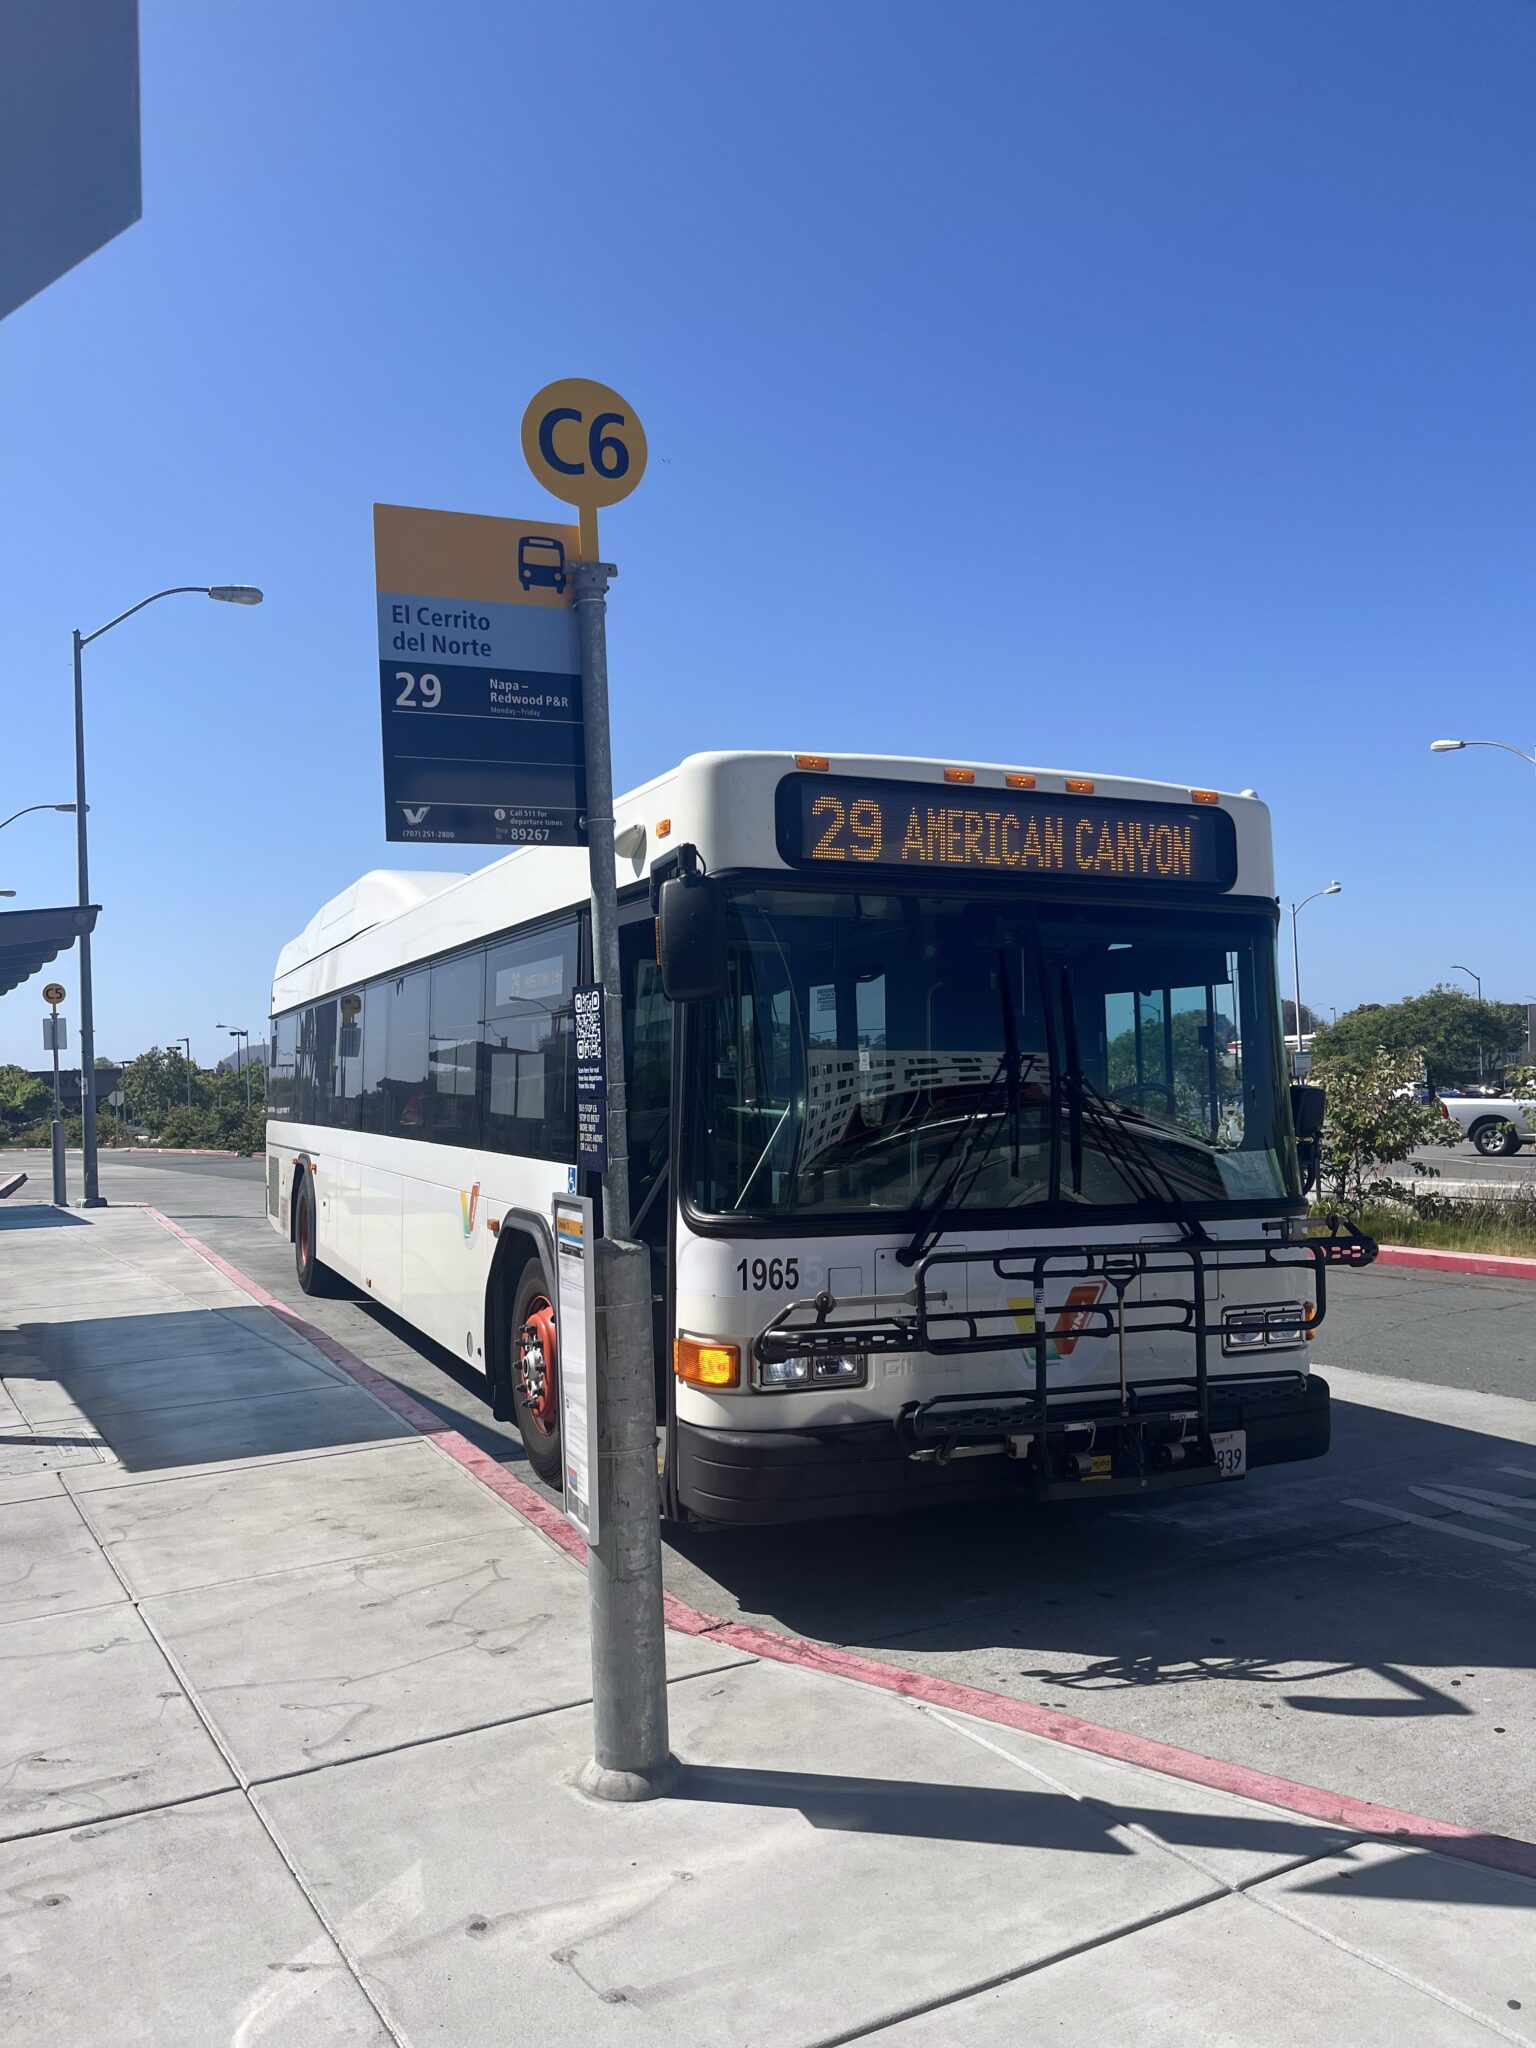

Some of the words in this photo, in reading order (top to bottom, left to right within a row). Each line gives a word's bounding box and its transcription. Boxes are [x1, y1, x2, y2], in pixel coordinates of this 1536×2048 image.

[538, 407, 629, 479] C6
[391, 604, 410, 624] El
[416, 607, 490, 631] Cerrito
[392, 631, 425, 652] del
[432, 634, 492, 657] Norte
[395, 671, 442, 708] 29
[489, 678, 519, 693] Napa
[490, 692, 543, 706] Redwood
[546, 695, 569, 707] P&R
[509, 809, 523, 817] Call
[537, 810, 548, 818] for
[510, 818, 544, 828] departure
[402, 830, 421, 838] (707)
[422, 830, 455, 839] 251-2800
[511, 827, 550, 841] 89267
[811, 795, 883, 863] 29
[901, 806, 1063, 869] AMERICAN
[1074, 818, 1191, 876] CANYON
[45, 987, 63, 1000] C5
[737, 1257, 799, 1291] 1965
